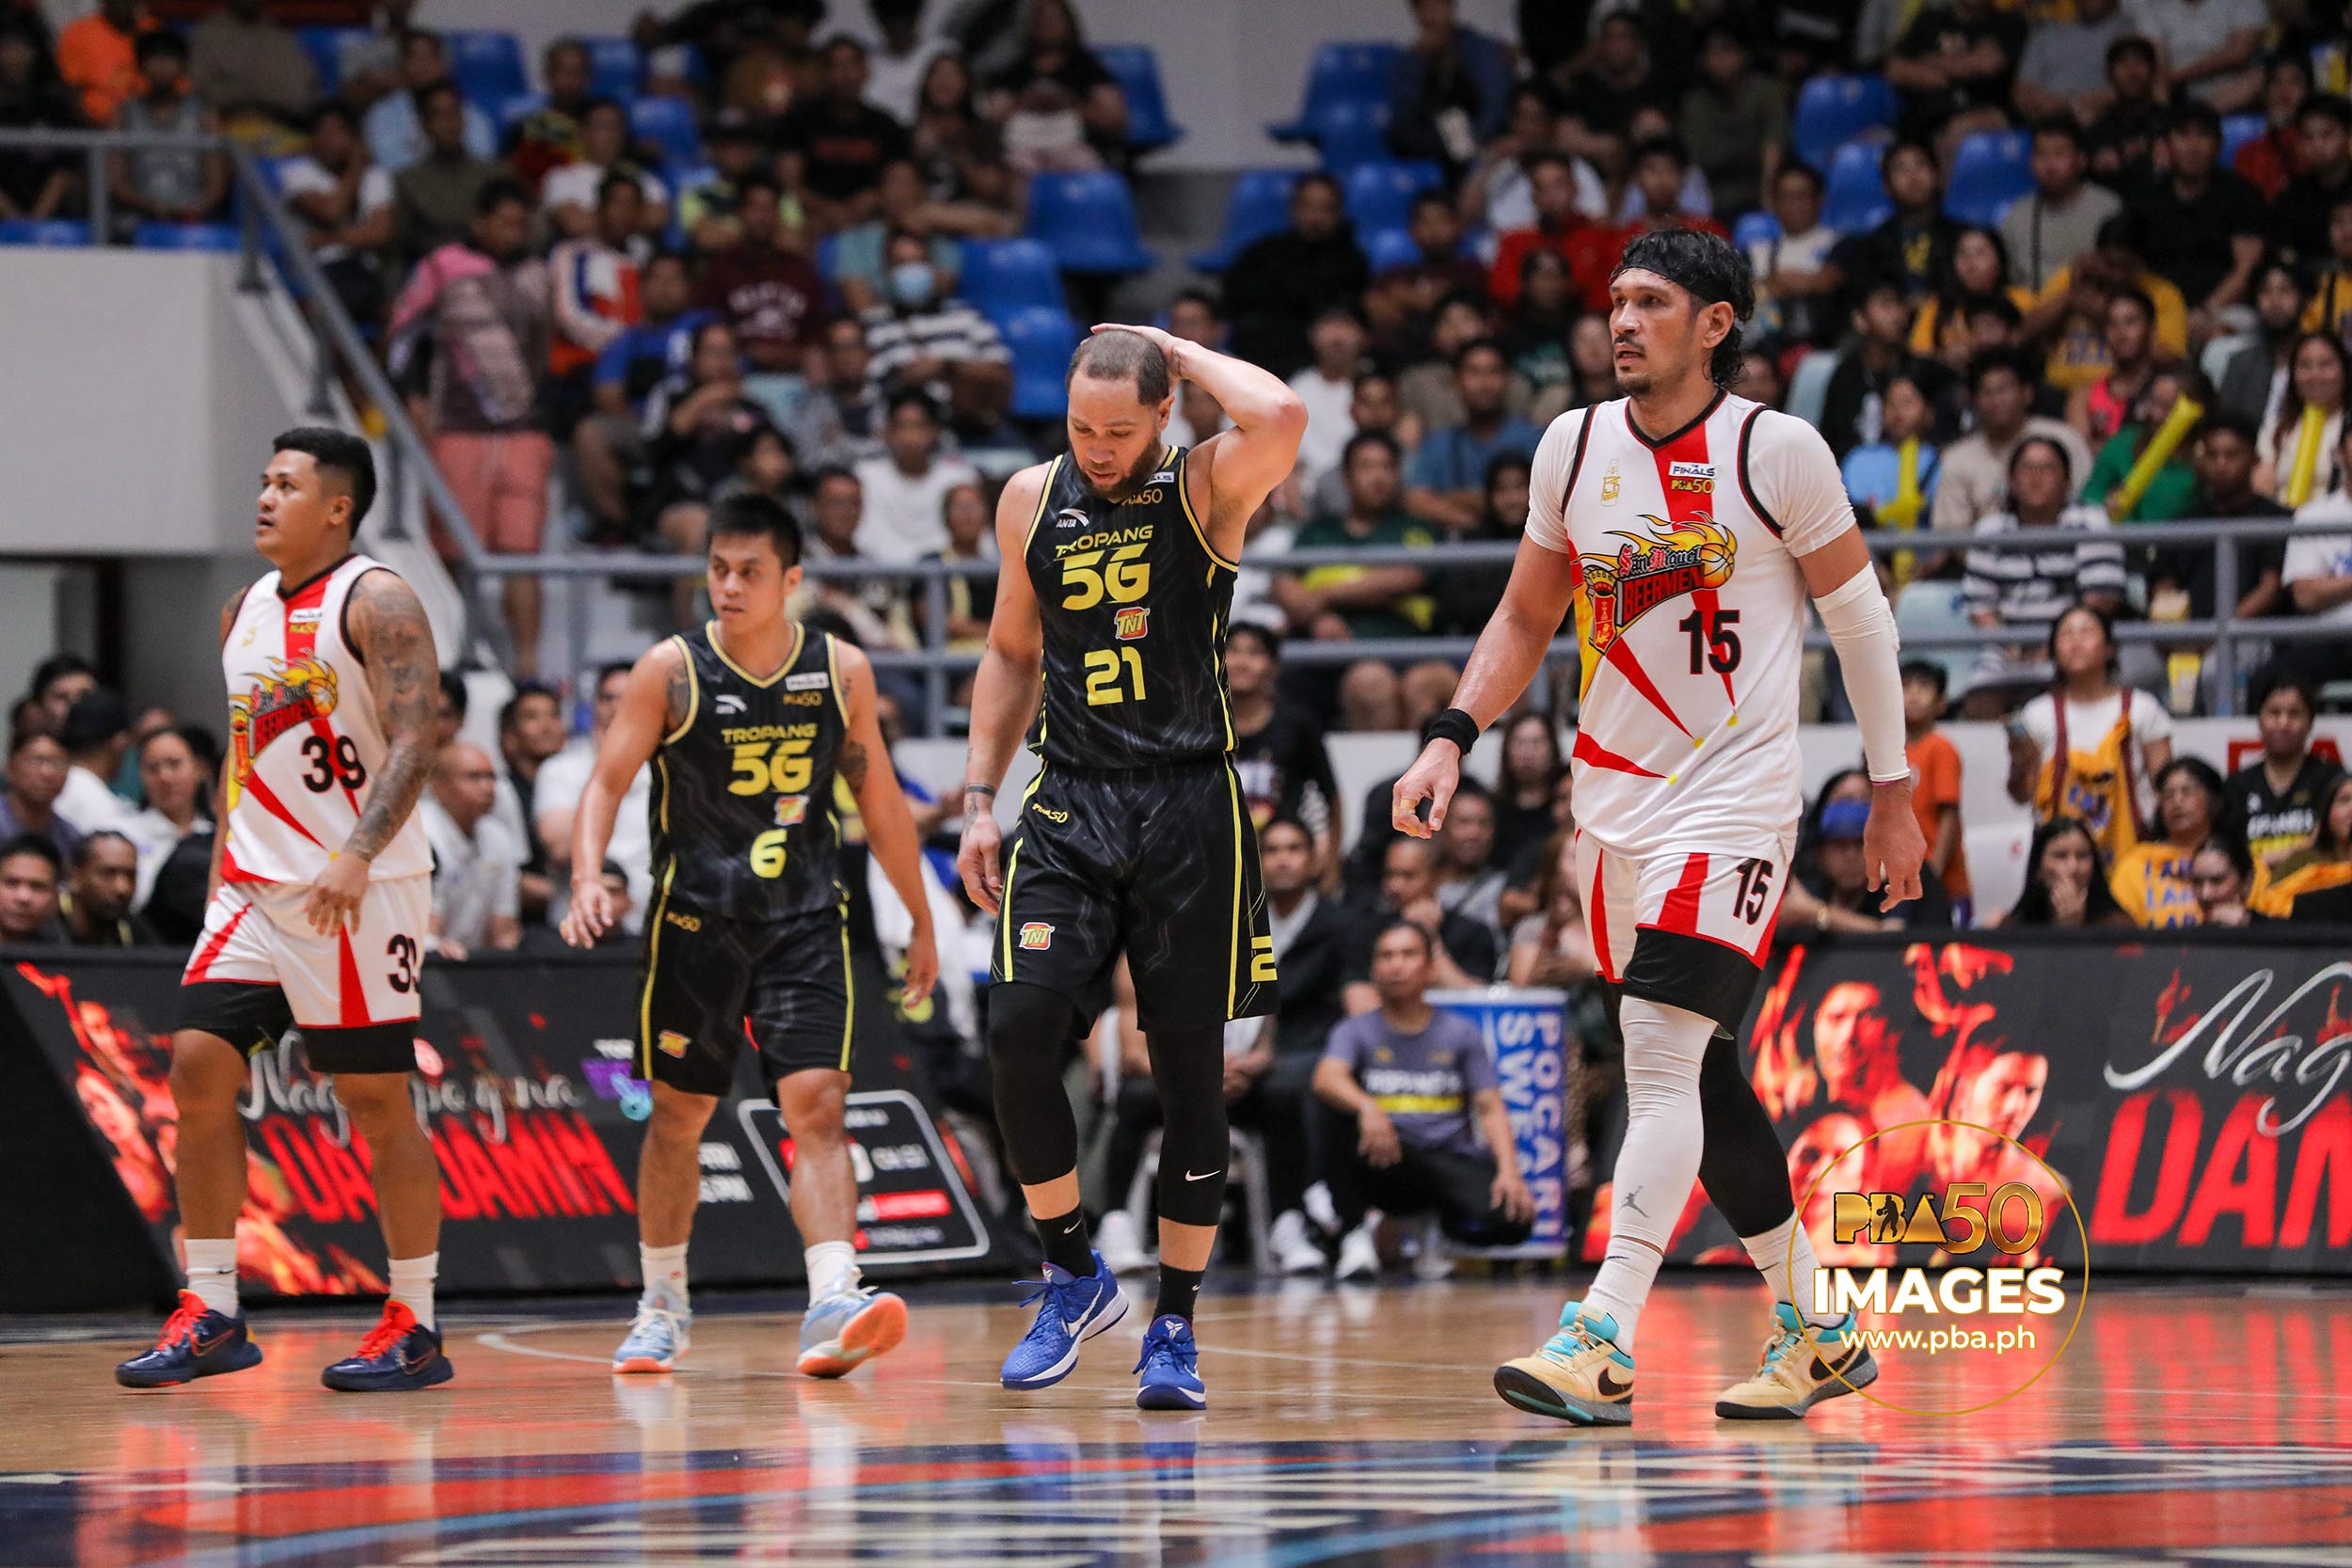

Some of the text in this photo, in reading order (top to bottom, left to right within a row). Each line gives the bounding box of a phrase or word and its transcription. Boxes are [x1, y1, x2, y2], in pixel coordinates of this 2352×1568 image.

[1672, 465, 1716, 478] FINALS
[1056, 518, 1077, 529] ANTA
[1056, 524, 1153, 559] TROPANG
[1054, 542, 1152, 610] 5G
[1618, 544, 1702, 578] San Miguel
[1623, 564, 1703, 625] BEERMEN
[1115, 609, 1150, 639] TNT
[1678, 609, 1741, 675] 15
[1084, 645, 1147, 706] 21
[721, 722, 818, 744] TROPANG
[301, 736, 367, 793] 39
[726, 738, 814, 796] 5G
[750, 828, 787, 879] 6
[1732, 857, 1774, 926] 15
[1021, 923, 1055, 948] TNT
[2103, 961, 2352, 1137] Nag
[1533, 1010, 1562, 1237] POCARI
